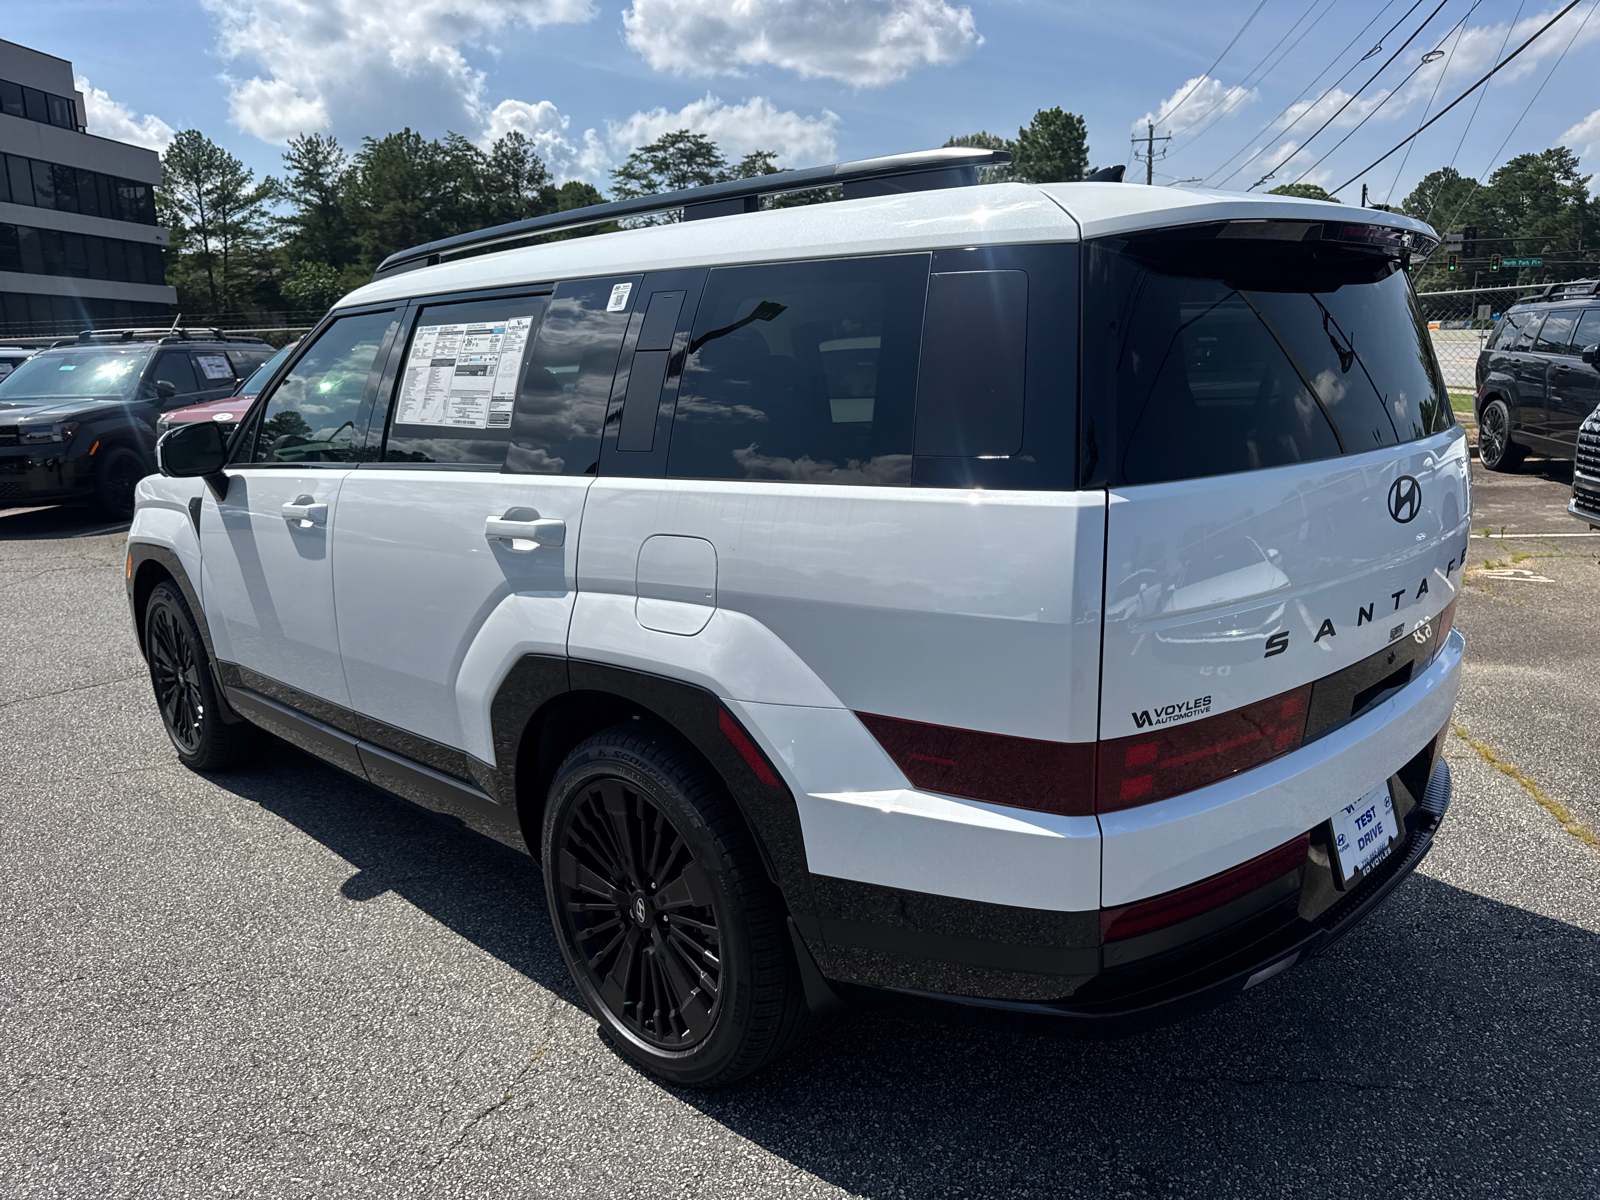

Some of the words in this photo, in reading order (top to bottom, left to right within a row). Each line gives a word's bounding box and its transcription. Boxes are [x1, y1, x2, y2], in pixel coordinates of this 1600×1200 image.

[1264, 578, 1429, 659] SANTA
[1154, 695, 1212, 718] VOYLES
[1154, 705, 1211, 726] AUTOMOTIVE
[1354, 805, 1377, 831] TEST
[1357, 820, 1384, 852] DRIVE
[1362, 866, 1371, 877] ED
[1371, 846, 1392, 869] VOYLES
